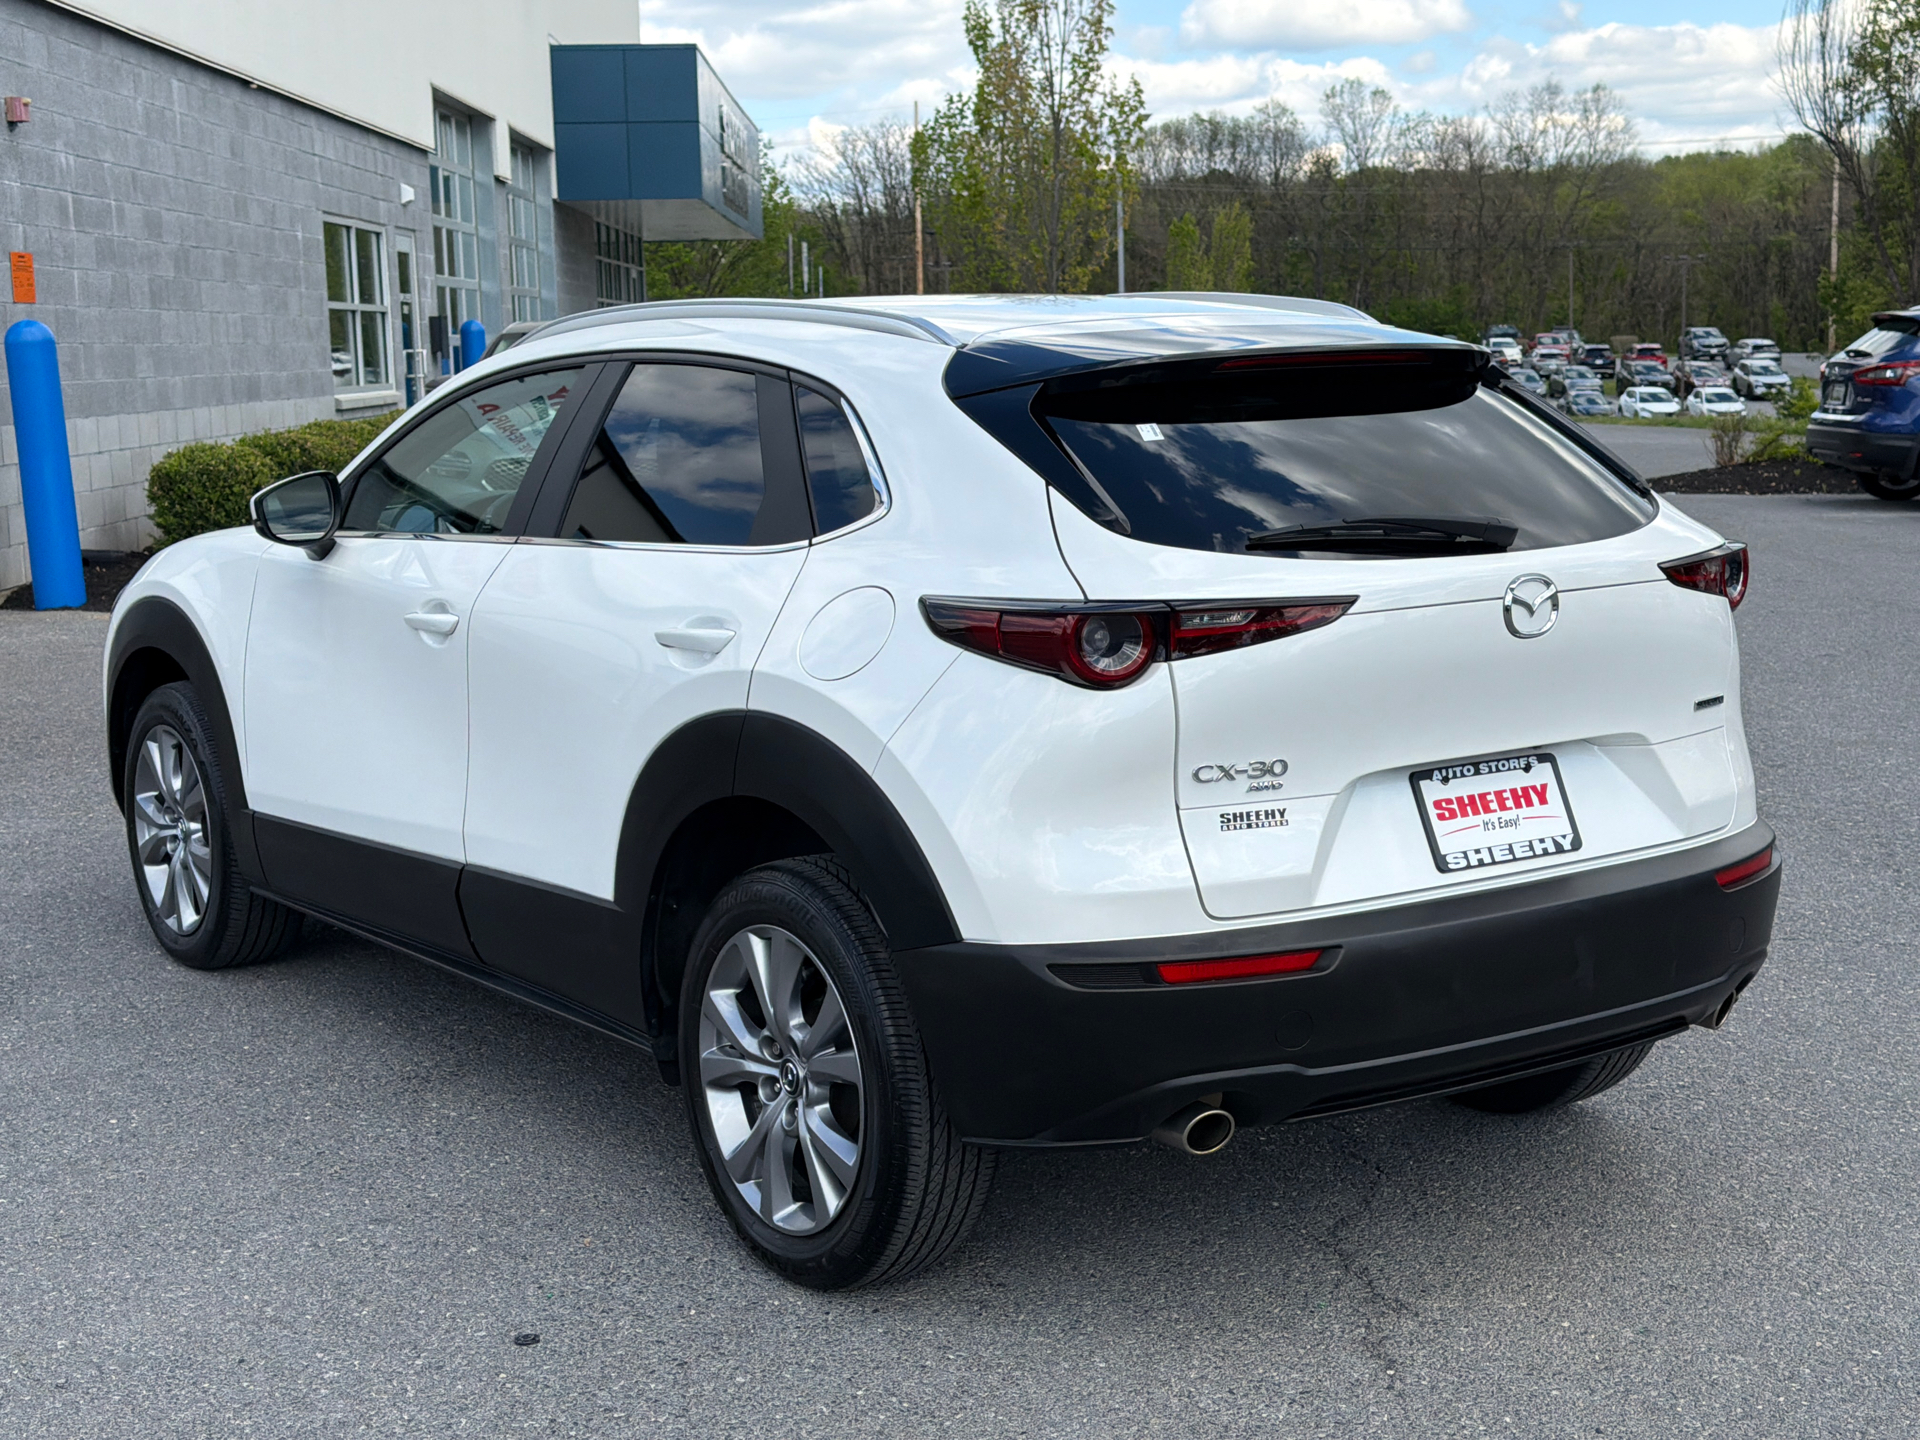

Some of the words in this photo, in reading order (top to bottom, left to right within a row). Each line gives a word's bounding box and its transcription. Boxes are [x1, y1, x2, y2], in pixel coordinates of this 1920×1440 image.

[1191, 758, 1288, 783] CX-30
[1431, 765, 1475, 782] AUTO
[1479, 756, 1539, 774] STORES
[1246, 780, 1284, 793] AWD
[1433, 783, 1549, 821] SHEEHY
[1219, 808, 1287, 824] SHEEHY
[1222, 822, 1248, 831] AUTO
[1251, 820, 1288, 829] STORES
[1482, 819, 1496, 832] It's
[1499, 814, 1521, 830] Easy!
[1446, 833, 1574, 869] SHEEHY
